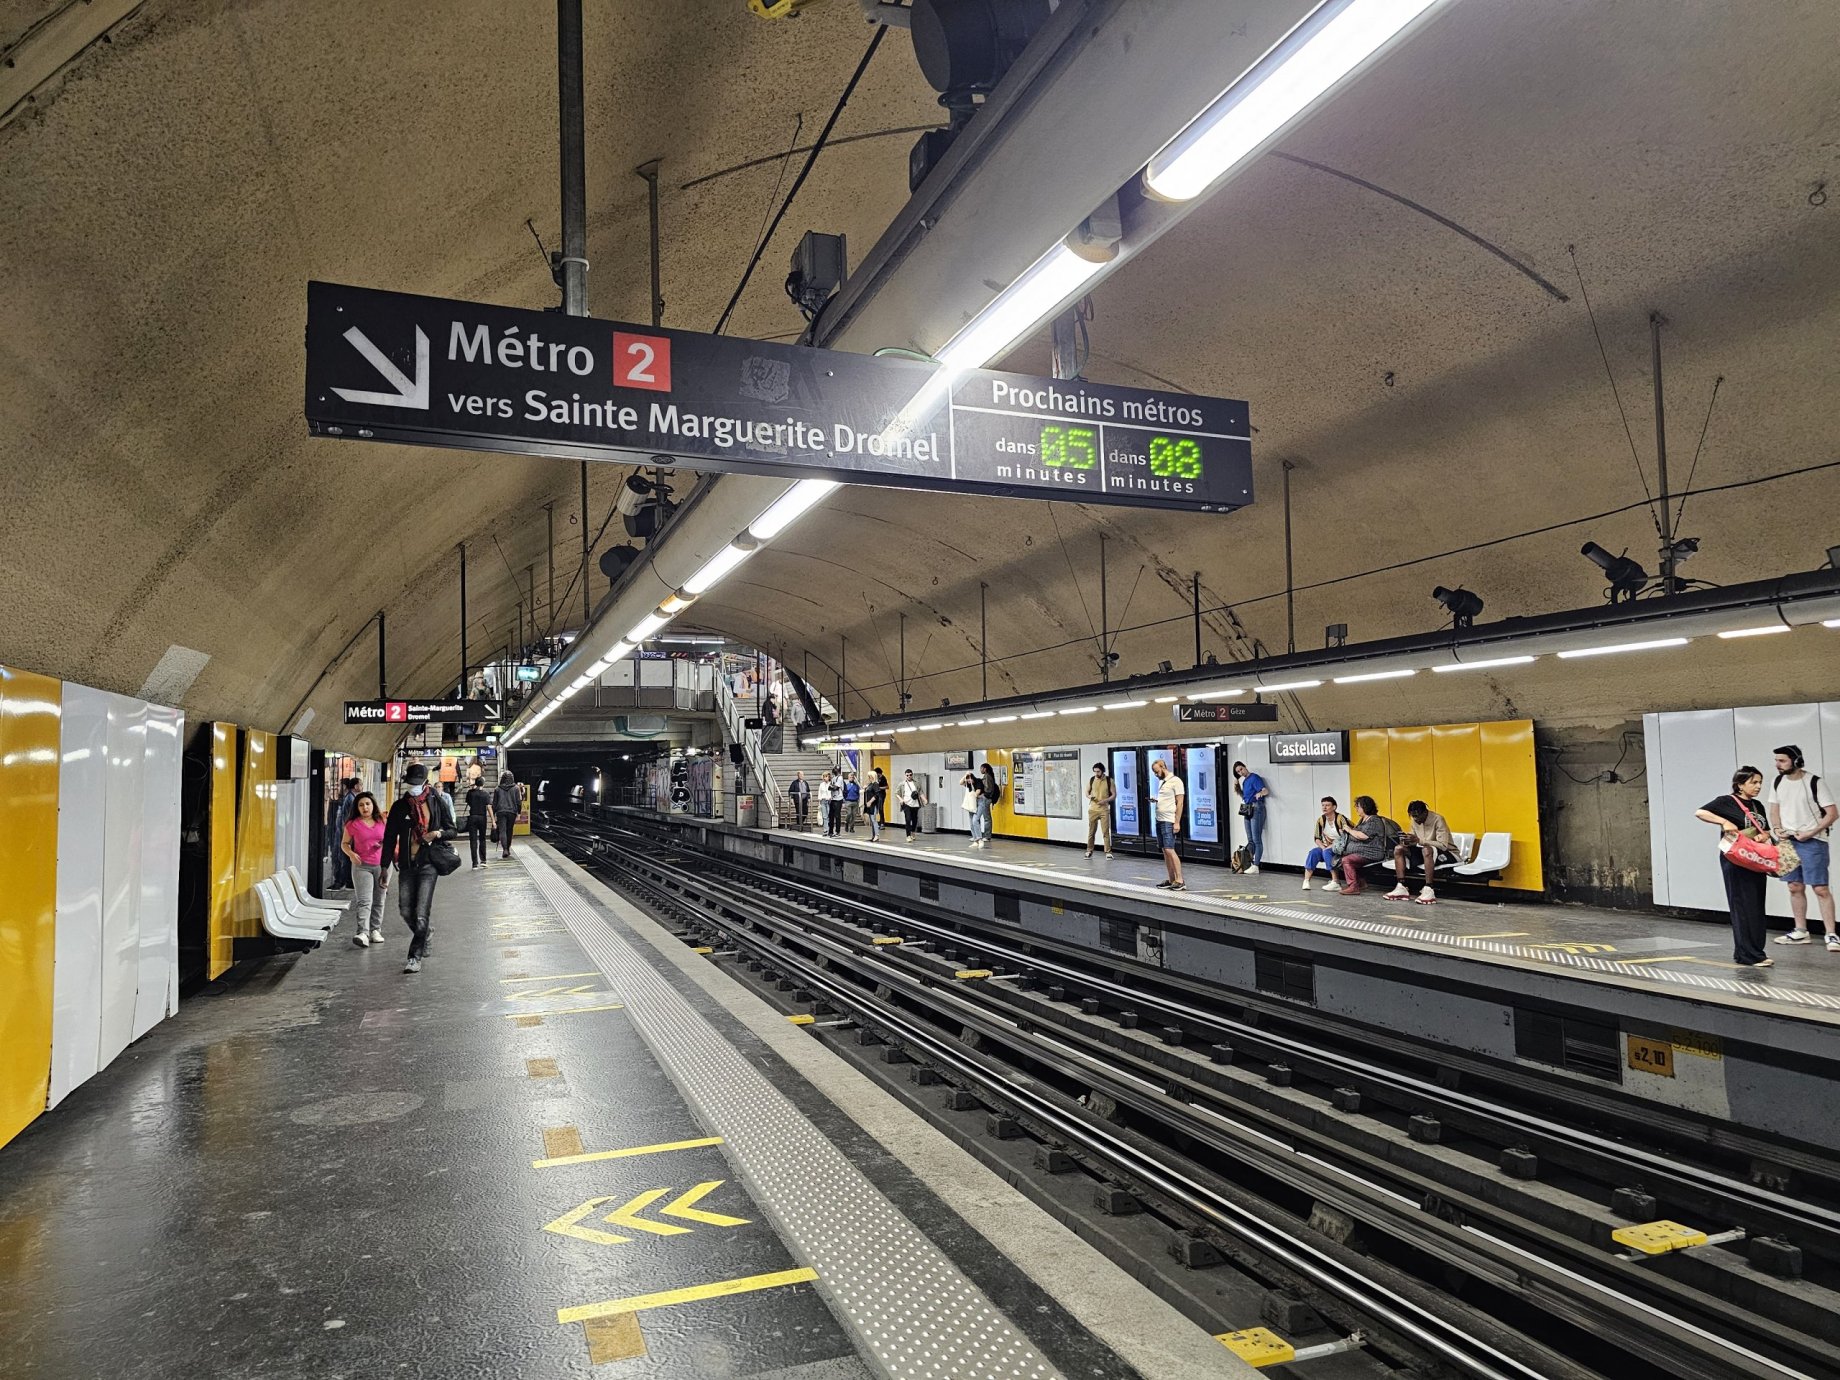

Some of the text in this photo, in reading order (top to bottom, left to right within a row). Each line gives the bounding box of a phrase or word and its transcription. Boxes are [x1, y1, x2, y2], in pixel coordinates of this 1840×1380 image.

[447, 321, 655, 383] Métro 2
[992, 379, 1204, 427] Prochains métros
[447, 389, 940, 462] vers Sainte Marguerite Dromel
[995, 437, 1036, 456] dans
[1040, 427, 1097, 470] 05
[1109, 447, 1147, 466] dans
[1149, 436, 1202, 479] 08
[996, 463, 1087, 485] minutes
[1110, 472, 1194, 494] minutes
[348, 705, 401, 720] Métro 2
[407, 704, 464, 713] Sainte-Marguerite
[407, 713, 431, 721] Dromel
[1193, 709, 1216, 718] Métro
[1219, 708, 1227, 718] 2
[1275, 740, 1336, 756] Castellane
[1738, 848, 1777, 869] adidas
